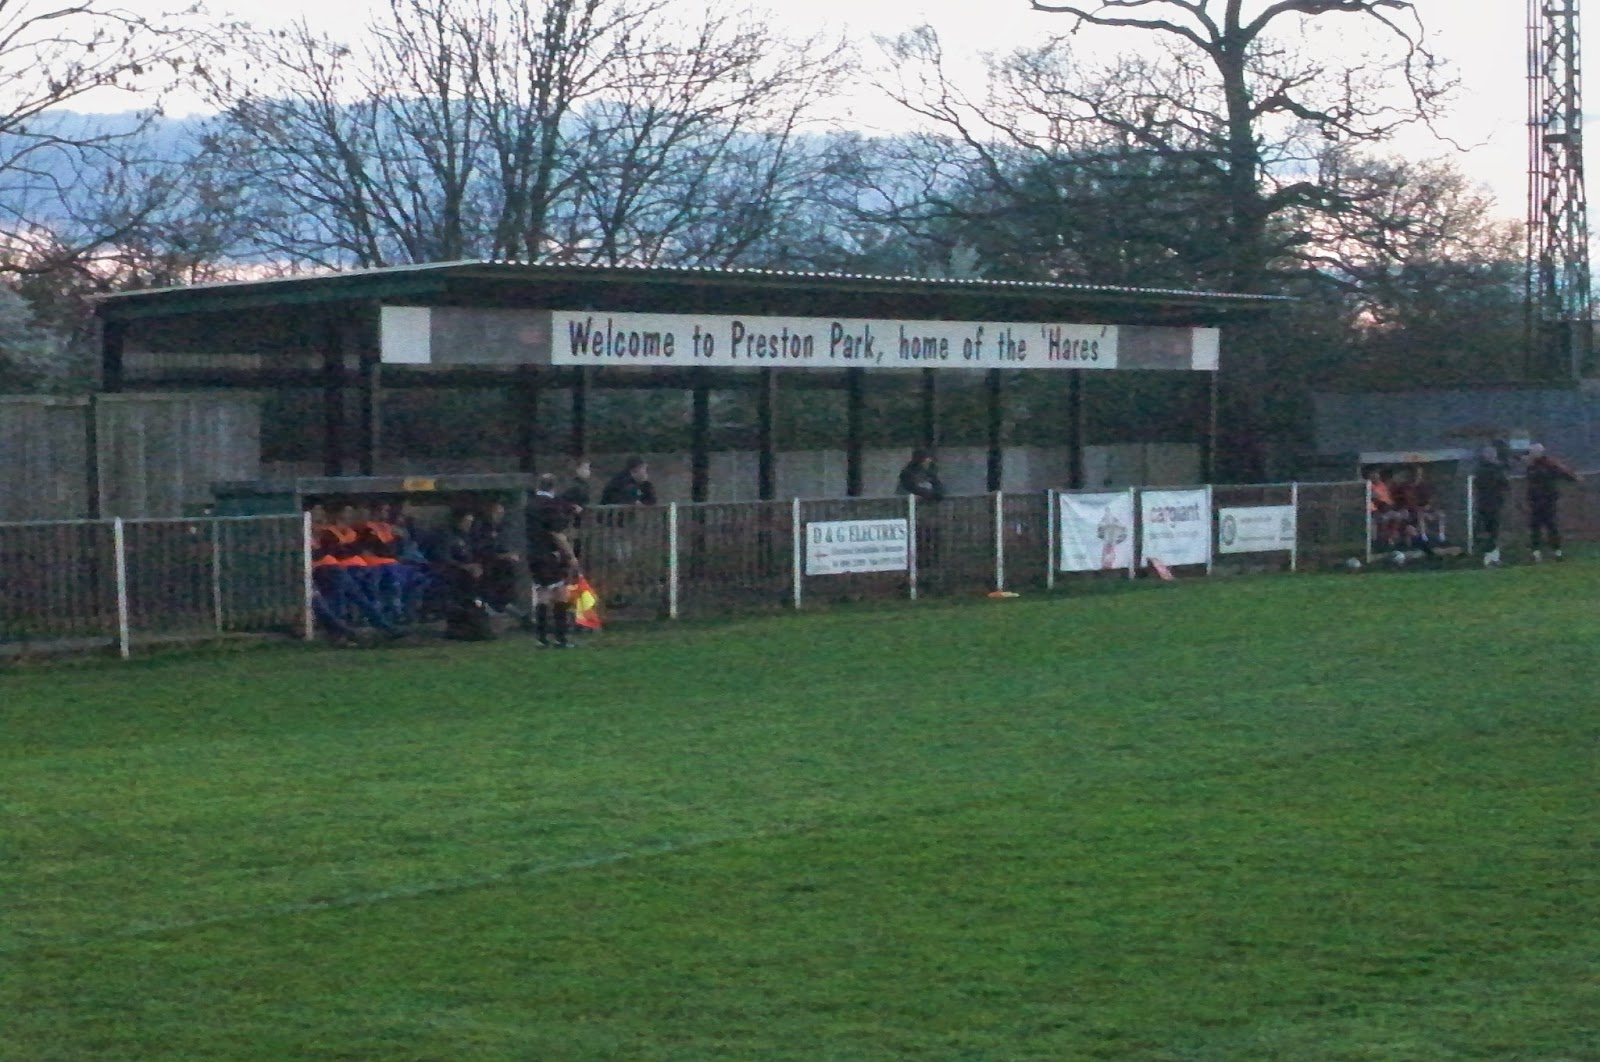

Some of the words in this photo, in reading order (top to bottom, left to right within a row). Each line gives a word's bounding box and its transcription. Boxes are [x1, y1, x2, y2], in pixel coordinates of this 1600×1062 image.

[568, 316, 675, 358] Welcome
[692, 324, 715, 358] to
[731, 320, 814, 358] Preston
[830, 321, 884, 365] Park,
[899, 324, 949, 361] home
[962, 325, 984, 361] of
[998, 327, 1027, 361] the
[813, 527, 823, 544] D
[836, 526, 846, 543] G
